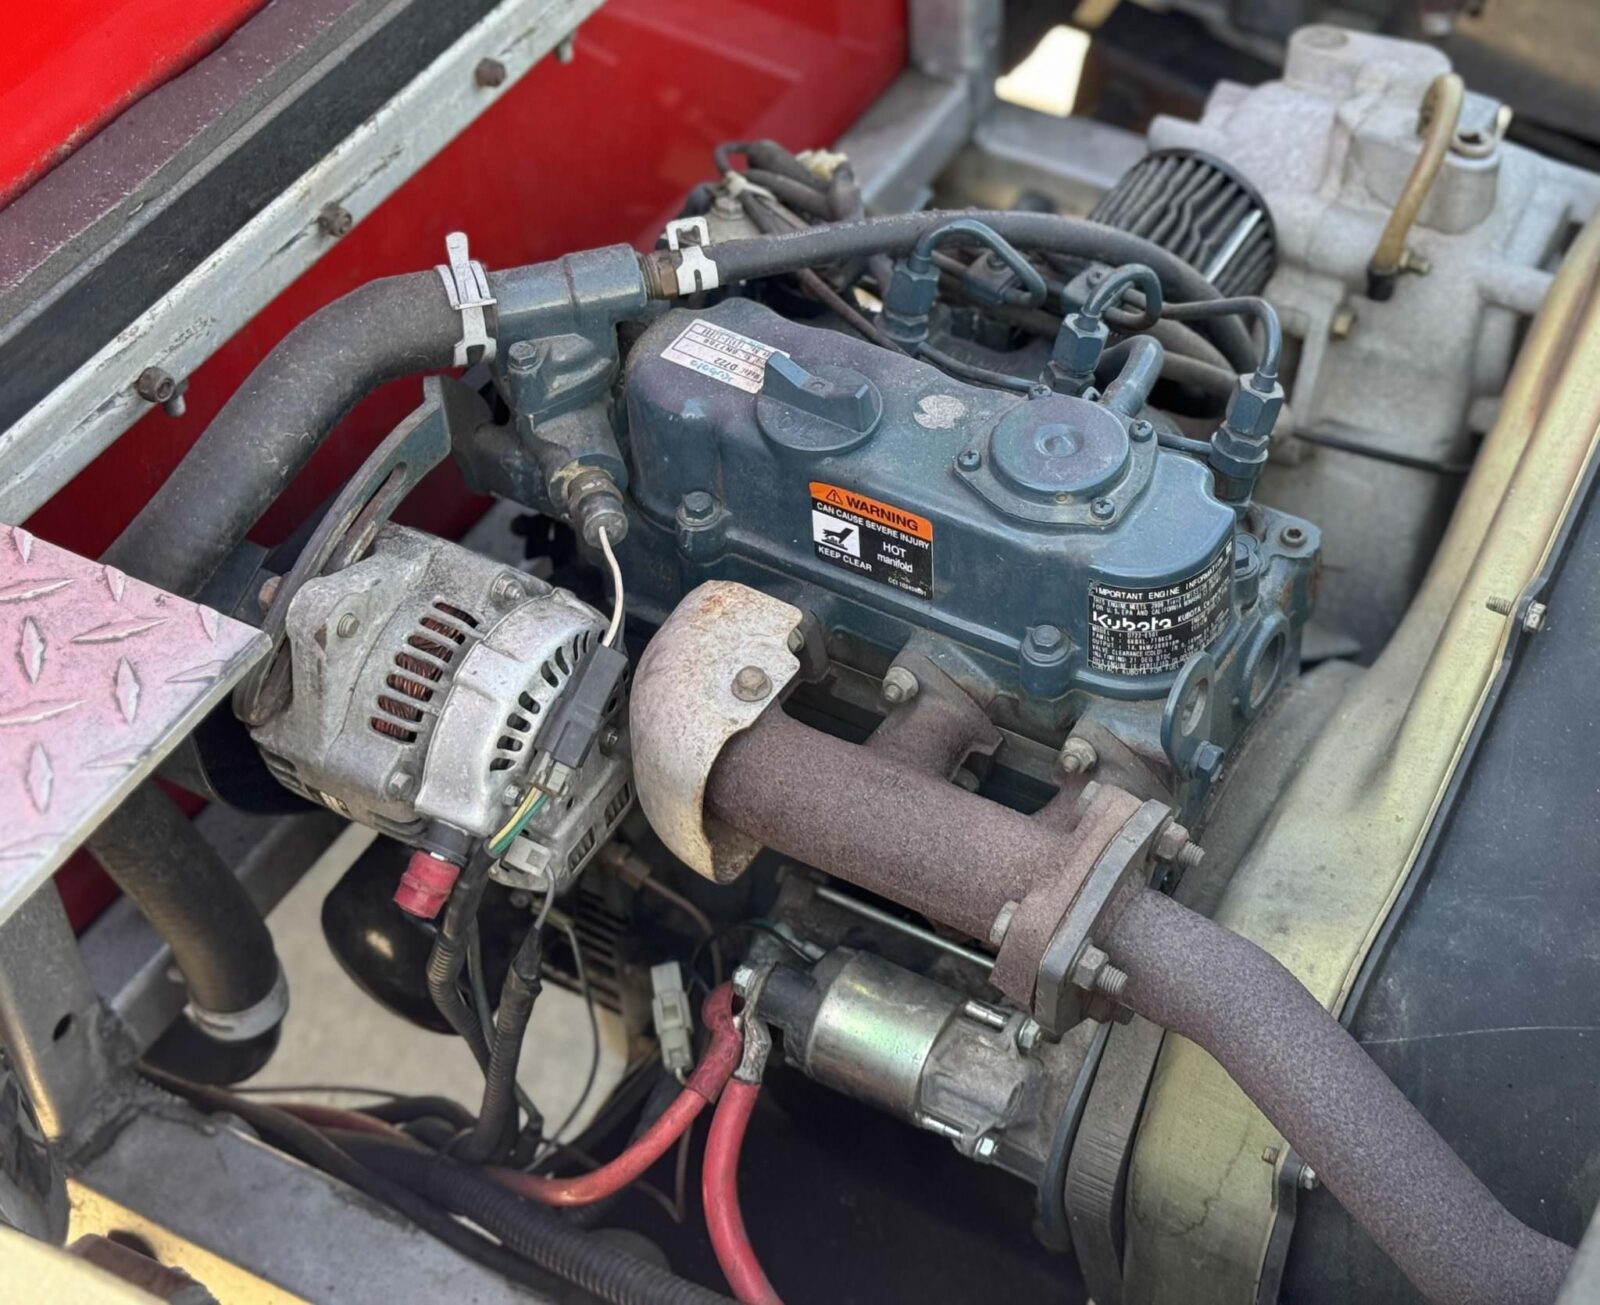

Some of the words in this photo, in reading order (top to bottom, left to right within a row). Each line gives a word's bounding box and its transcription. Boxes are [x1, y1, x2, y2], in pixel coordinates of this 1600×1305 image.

[713, 357, 739, 371] D722
[846, 495, 918, 531] WARNING
[816, 502, 835, 515] CAN
[836, 509, 864, 526] CAUSE
[865, 519, 899, 539] SEVERE
[900, 530, 930, 550] INJURY
[818, 546, 841, 559] KEEP
[843, 554, 873, 572] CLEAR
[882, 541, 907, 558] HOT
[877, 553, 913, 573] manifold
[1095, 586, 1143, 600] IMPORTANT
[1148, 586, 1180, 600] ENGINE
[1092, 610, 1172, 632] Kubota
[1177, 606, 1201, 623] KUBOTA
